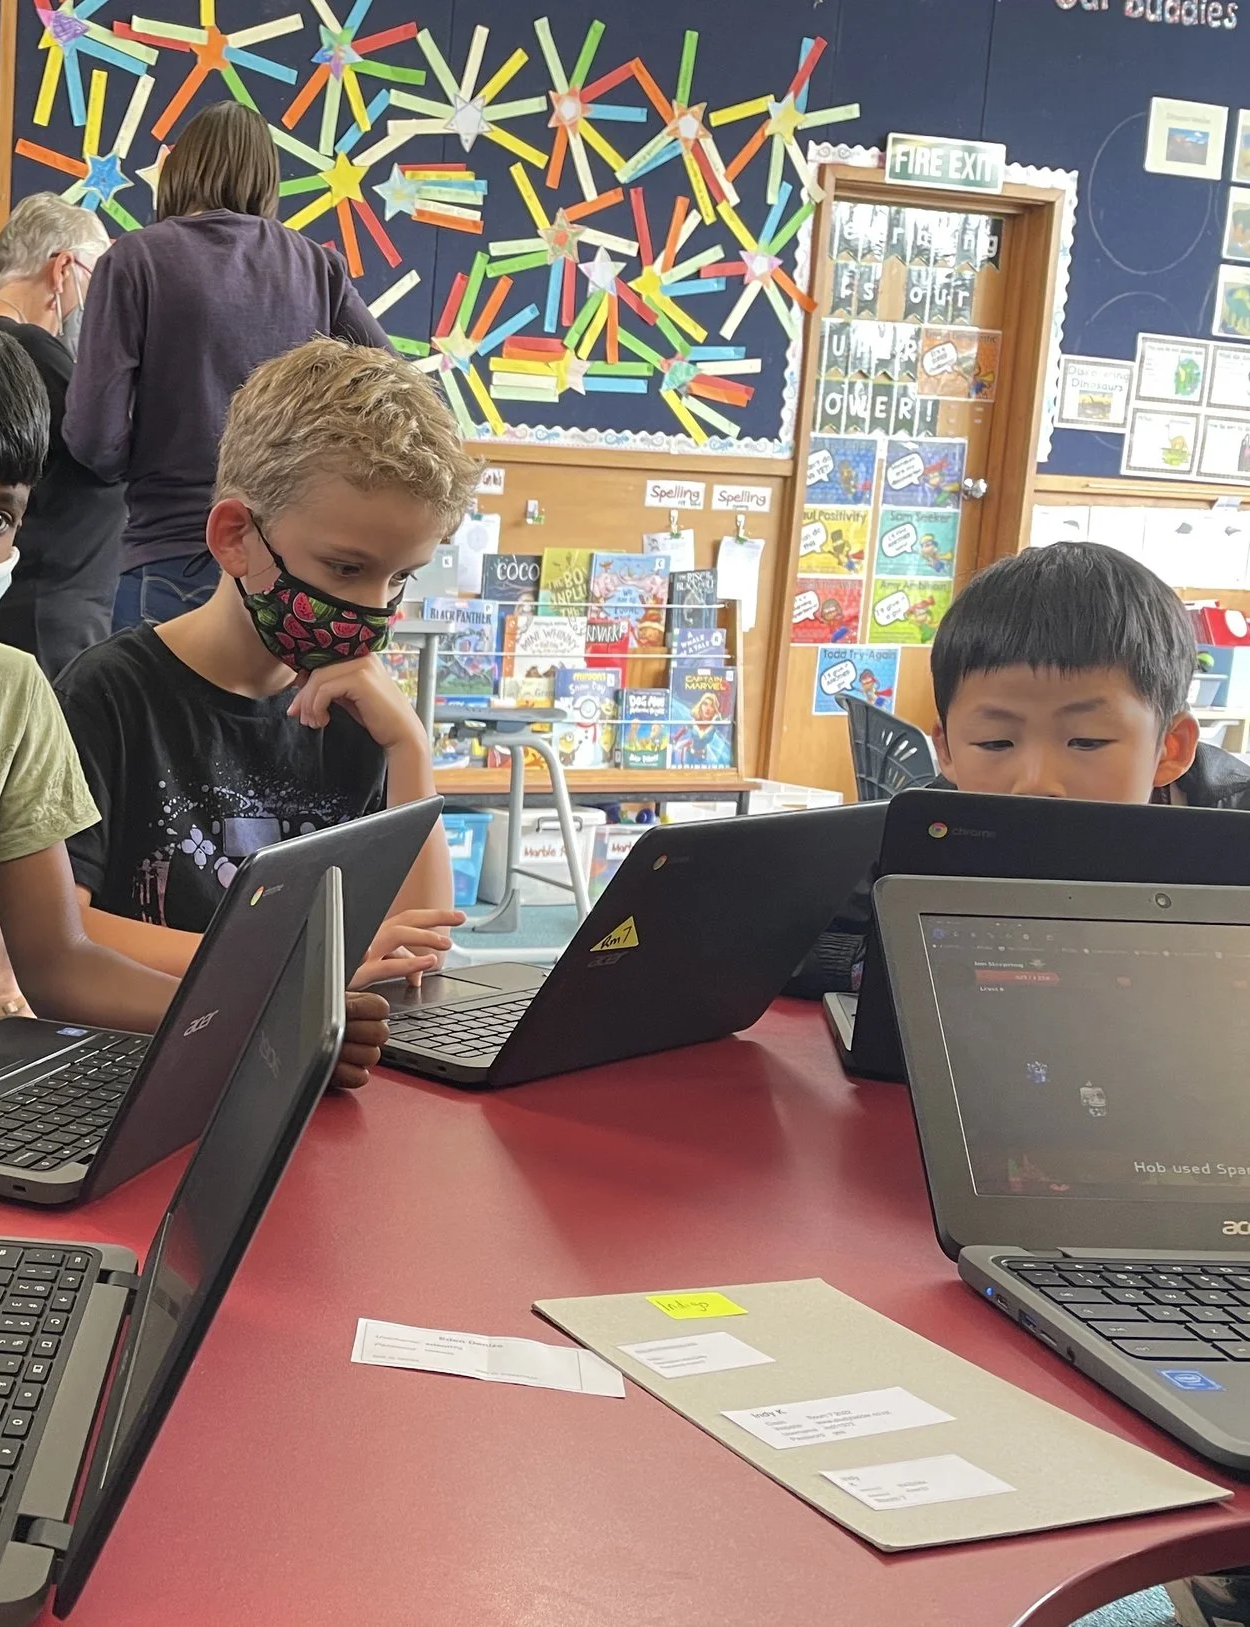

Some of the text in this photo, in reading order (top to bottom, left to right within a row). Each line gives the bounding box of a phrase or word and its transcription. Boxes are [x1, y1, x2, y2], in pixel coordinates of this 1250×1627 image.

[895, 145, 996, 182] FIRE EXIT
[1068, 364, 1131, 383] Discoering
[824, 391, 935, 423] OWER!
[650, 485, 701, 503] Spelling
[717, 490, 767, 507] Spelling
[802, 510, 867, 525] aul Positivity
[496, 561, 540, 581] COCO
[430, 608, 492, 625] BLACK PANTHER
[823, 649, 896, 661] Todd Try-Again
[685, 675, 723, 683] CAPTAIN
[685, 682, 726, 691] MARVEL
[524, 845, 556, 857] Marble
[601, 926, 633, 950] Rm 7
[183, 1009, 219, 1037] acer
[1133, 1161, 1167, 1174] Hob
[1172, 1163, 1211, 1175] used
[1222, 1220, 1250, 1235] ac
[751, 1409, 776, 1420] Indy
